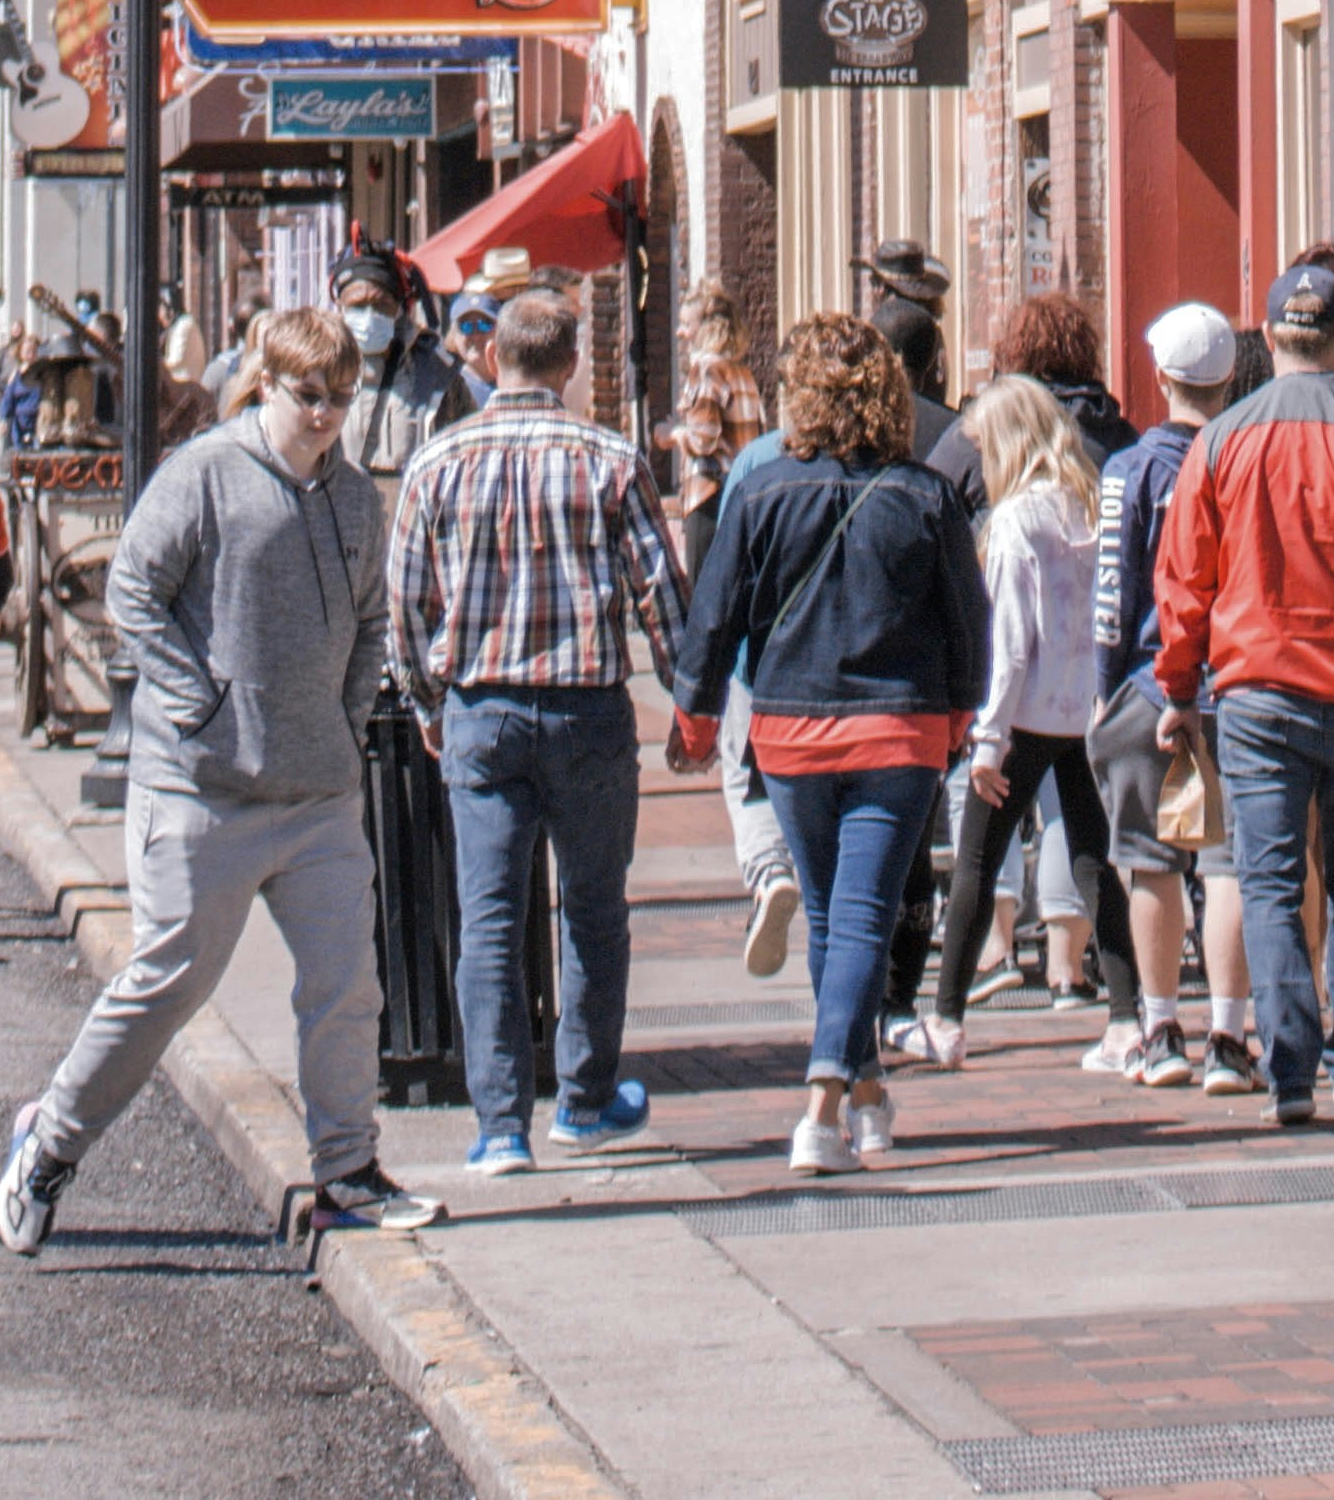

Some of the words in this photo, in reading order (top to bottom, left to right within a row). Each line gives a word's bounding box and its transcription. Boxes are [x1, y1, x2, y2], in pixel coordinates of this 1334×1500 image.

[830, 67, 918, 84] ENTRANCE
[277, 87, 427, 131] Layla's
[1094, 476, 1127, 648] HOLLISTER
